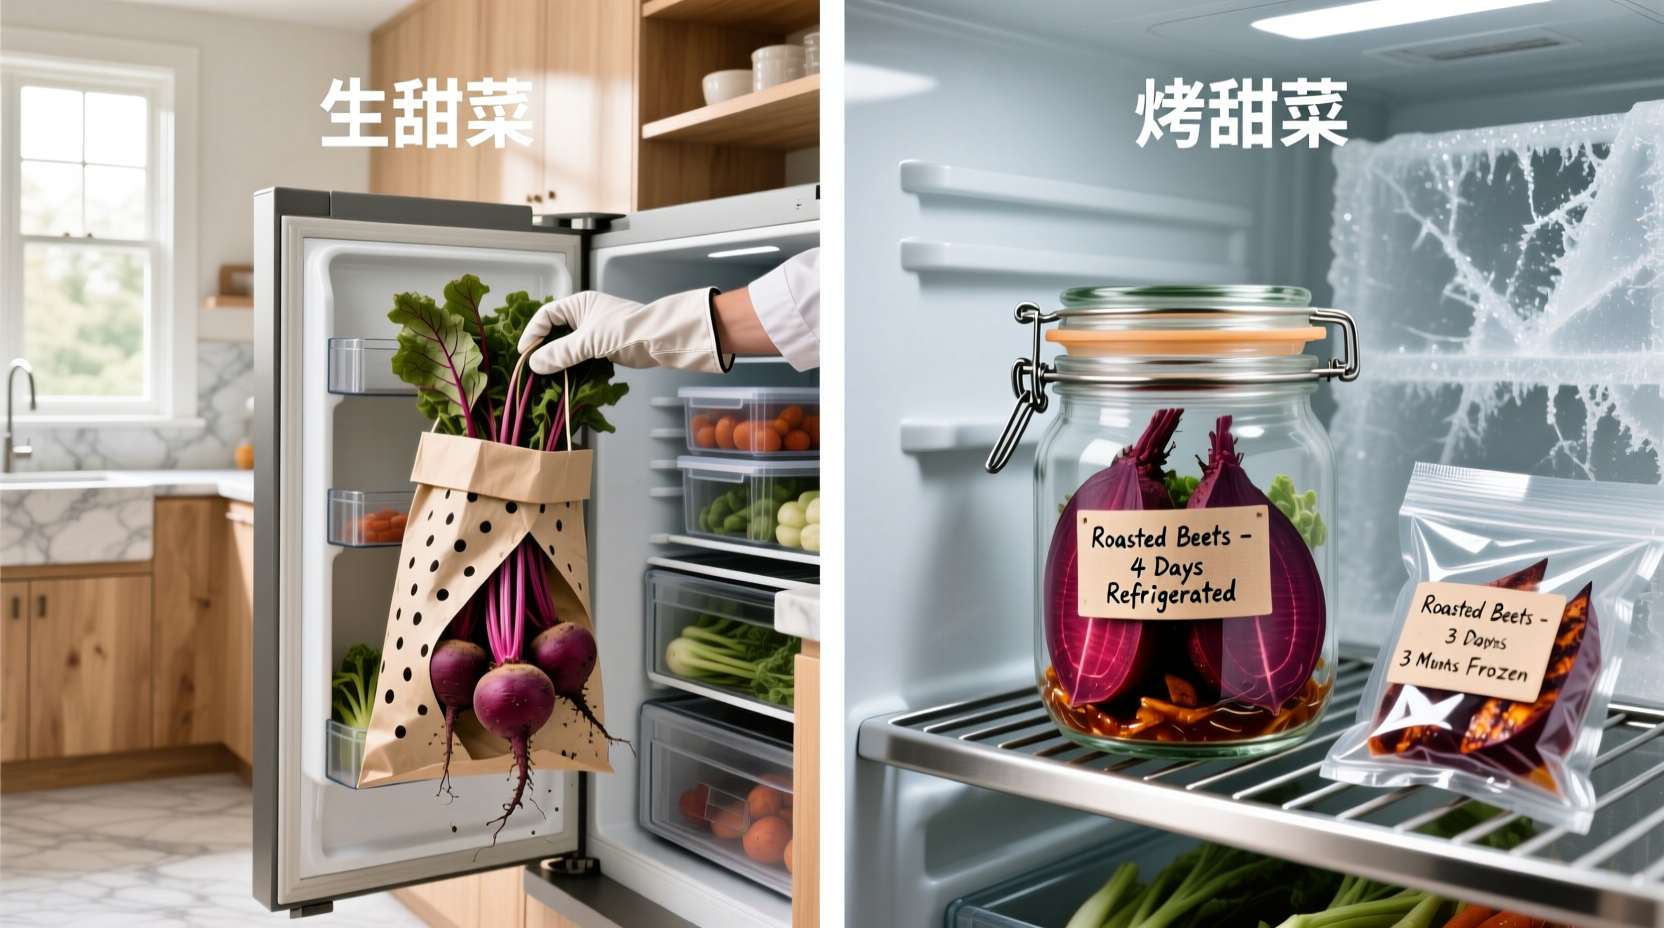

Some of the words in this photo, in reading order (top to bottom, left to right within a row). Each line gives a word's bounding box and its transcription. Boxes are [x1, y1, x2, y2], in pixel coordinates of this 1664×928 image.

[1091, 525, 1167, 549] Roasted
[1176, 524, 1231, 548] Beets
[1130, 556, 1146, 579] 4
[1153, 555, 1204, 585] Days
[1106, 578, 1236, 613] Refrigerated
[1420, 594, 1487, 619] Roasted
[1489, 602, 1534, 626] Beets
[1444, 628, 1458, 644] 3
[1399, 650, 1412, 667] 3
[1465, 656, 1528, 683] Frozen
